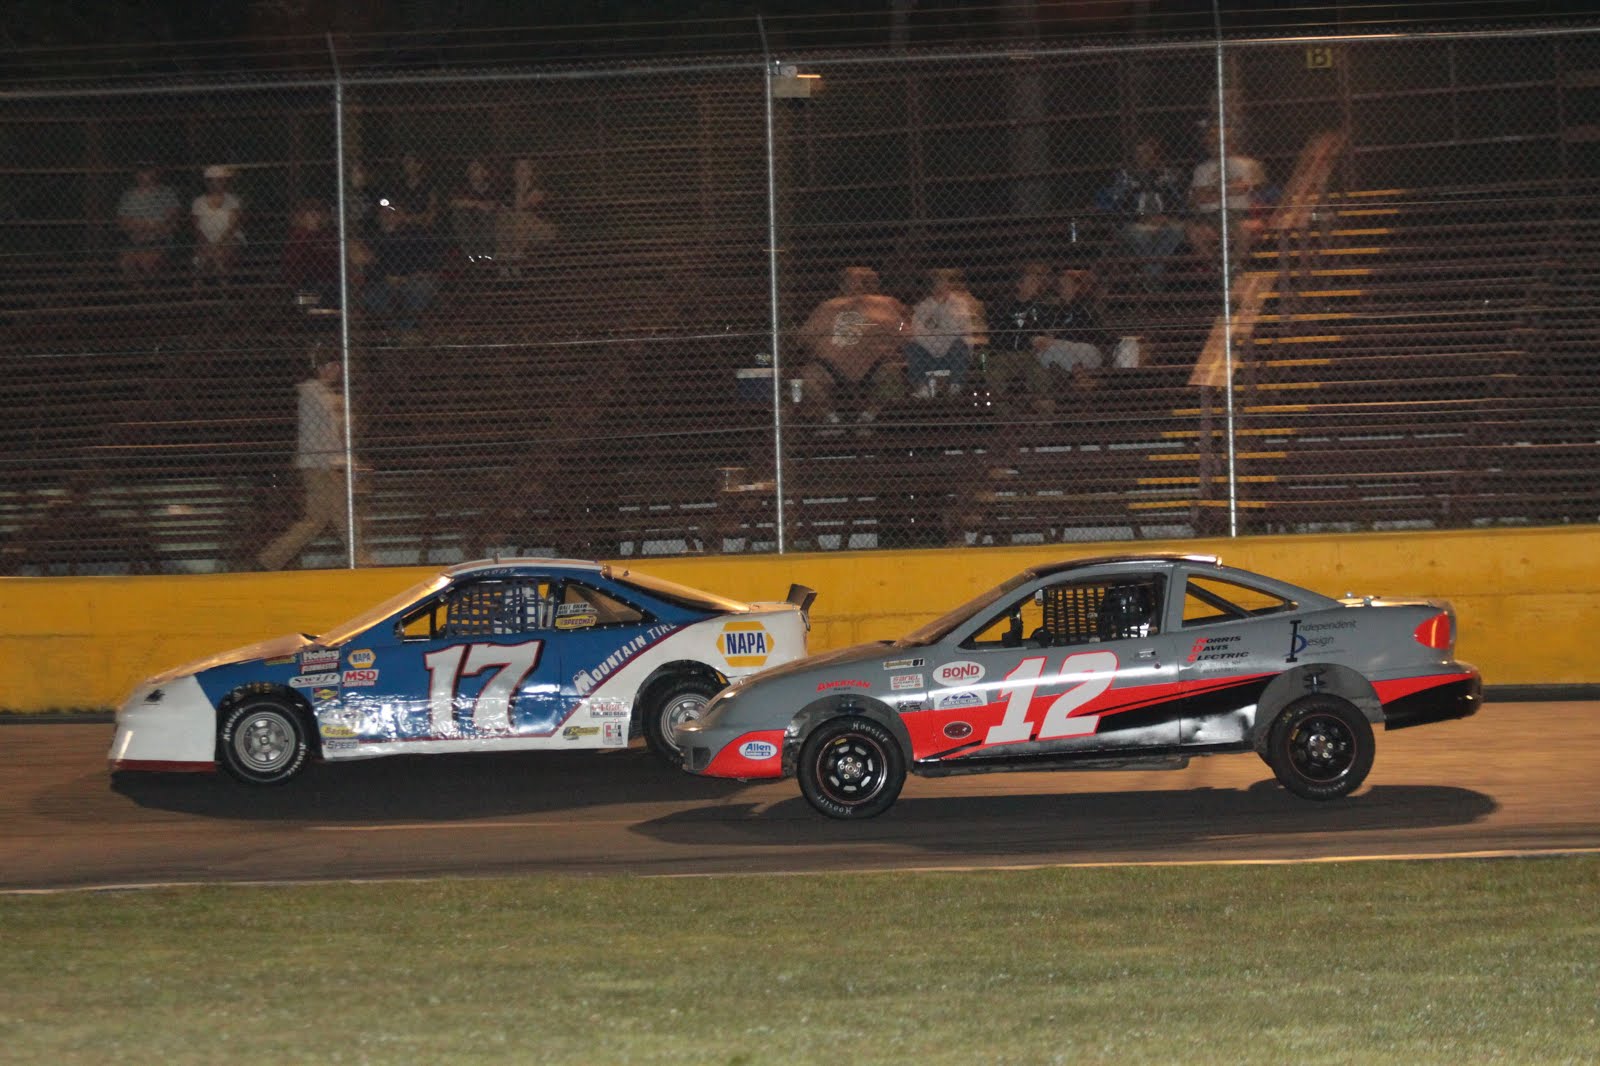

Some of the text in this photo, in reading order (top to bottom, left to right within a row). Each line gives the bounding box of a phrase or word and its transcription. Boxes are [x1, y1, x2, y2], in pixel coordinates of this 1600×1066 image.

[726, 632, 766, 654] NAPA
[1191, 644, 1228, 652] DAVIS
[573, 624, 676, 696] MOUNTAIN TIRE
[344, 670, 376, 681] MSD
[942, 663, 980, 680] BOND
[423, 640, 546, 738] 17
[816, 679, 871, 692] AMERICAN
[983, 650, 1120, 746] 12
[851, 721, 888, 743] Hoosier
[745, 742, 772, 751] Allen
